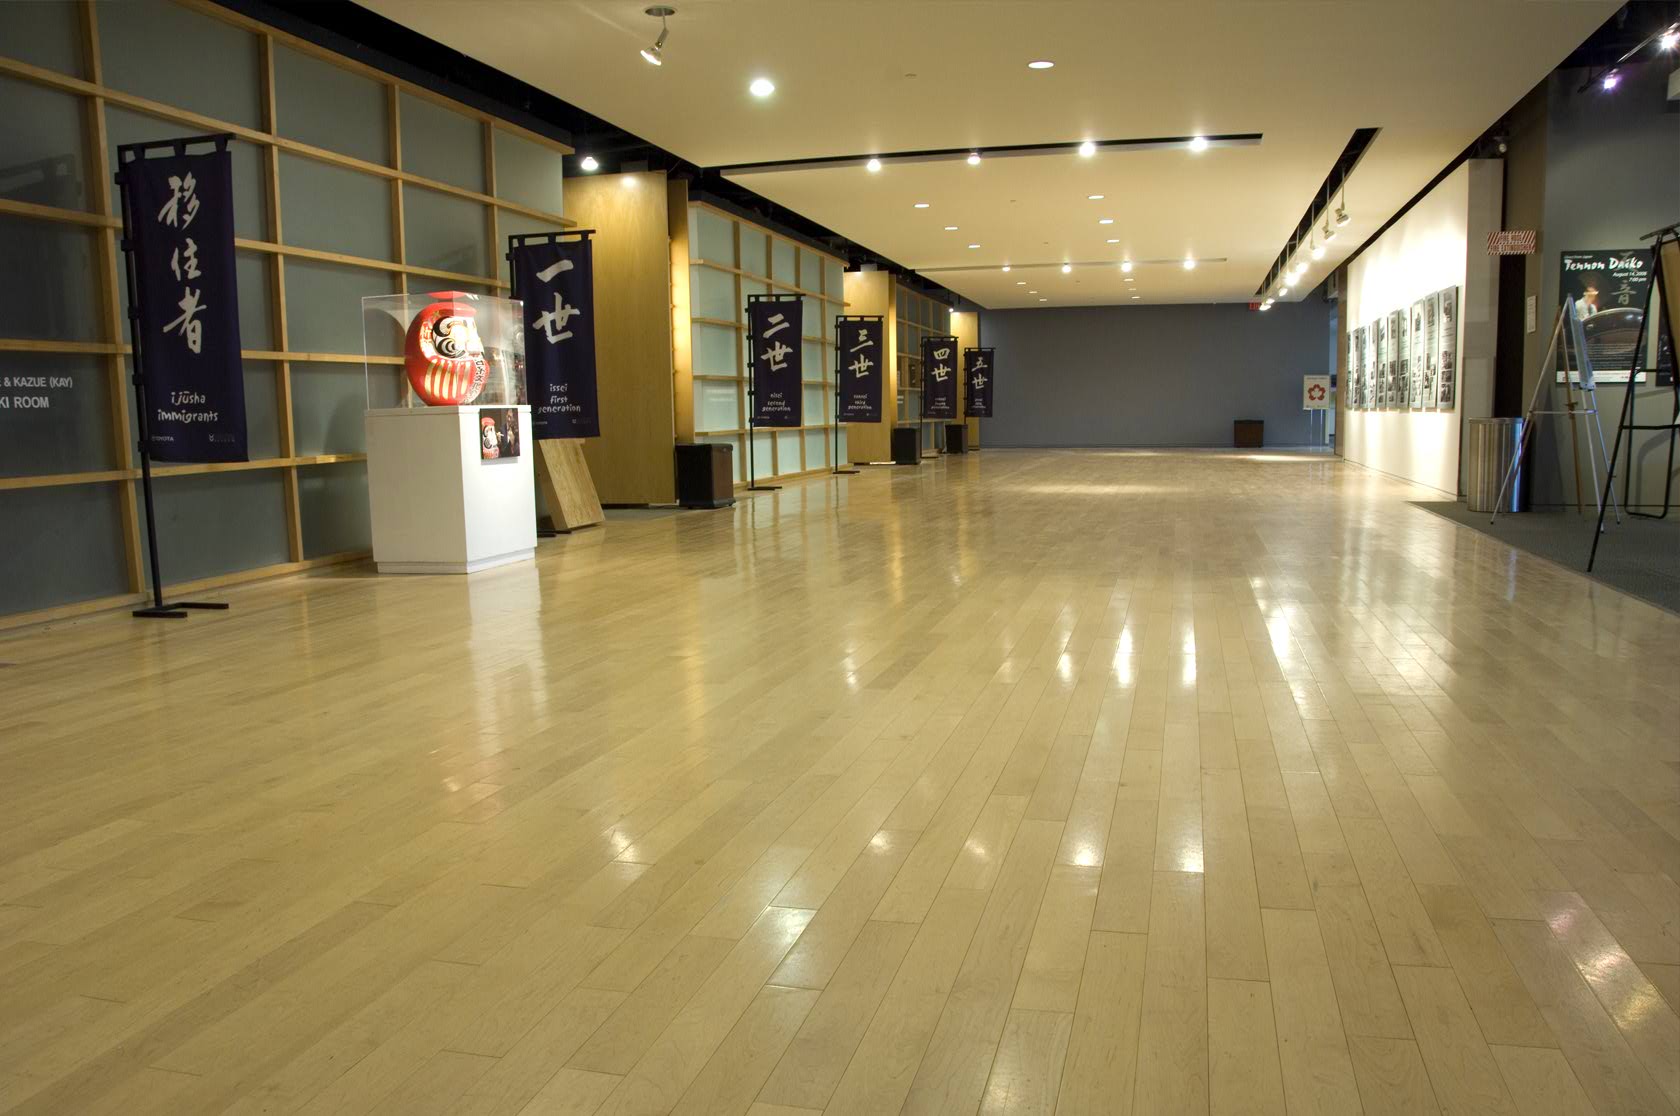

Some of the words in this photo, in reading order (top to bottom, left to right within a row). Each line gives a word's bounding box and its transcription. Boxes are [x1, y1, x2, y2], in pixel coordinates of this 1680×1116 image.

[158, 171, 207, 354] 移住者
[1564, 258, 1605, 271] Tennon
[1609, 257, 1643, 270] Daiko
[532, 259, 581, 344] 一世
[760, 313, 793, 372] 二世
[848, 329, 874, 378] 三世
[931, 348, 951, 382] 四世
[971, 357, 988, 389] 五世
[3, 376, 12, 387] &
[13, 376, 47, 387] KAZUE
[49, 376, 73, 389] (KAY)
[550, 383, 568, 392] issei
[13, 396, 49, 408] ROOM
[550, 395, 568, 404] first
[157, 409, 218, 424] immigrants
[537, 404, 581, 415] generation
